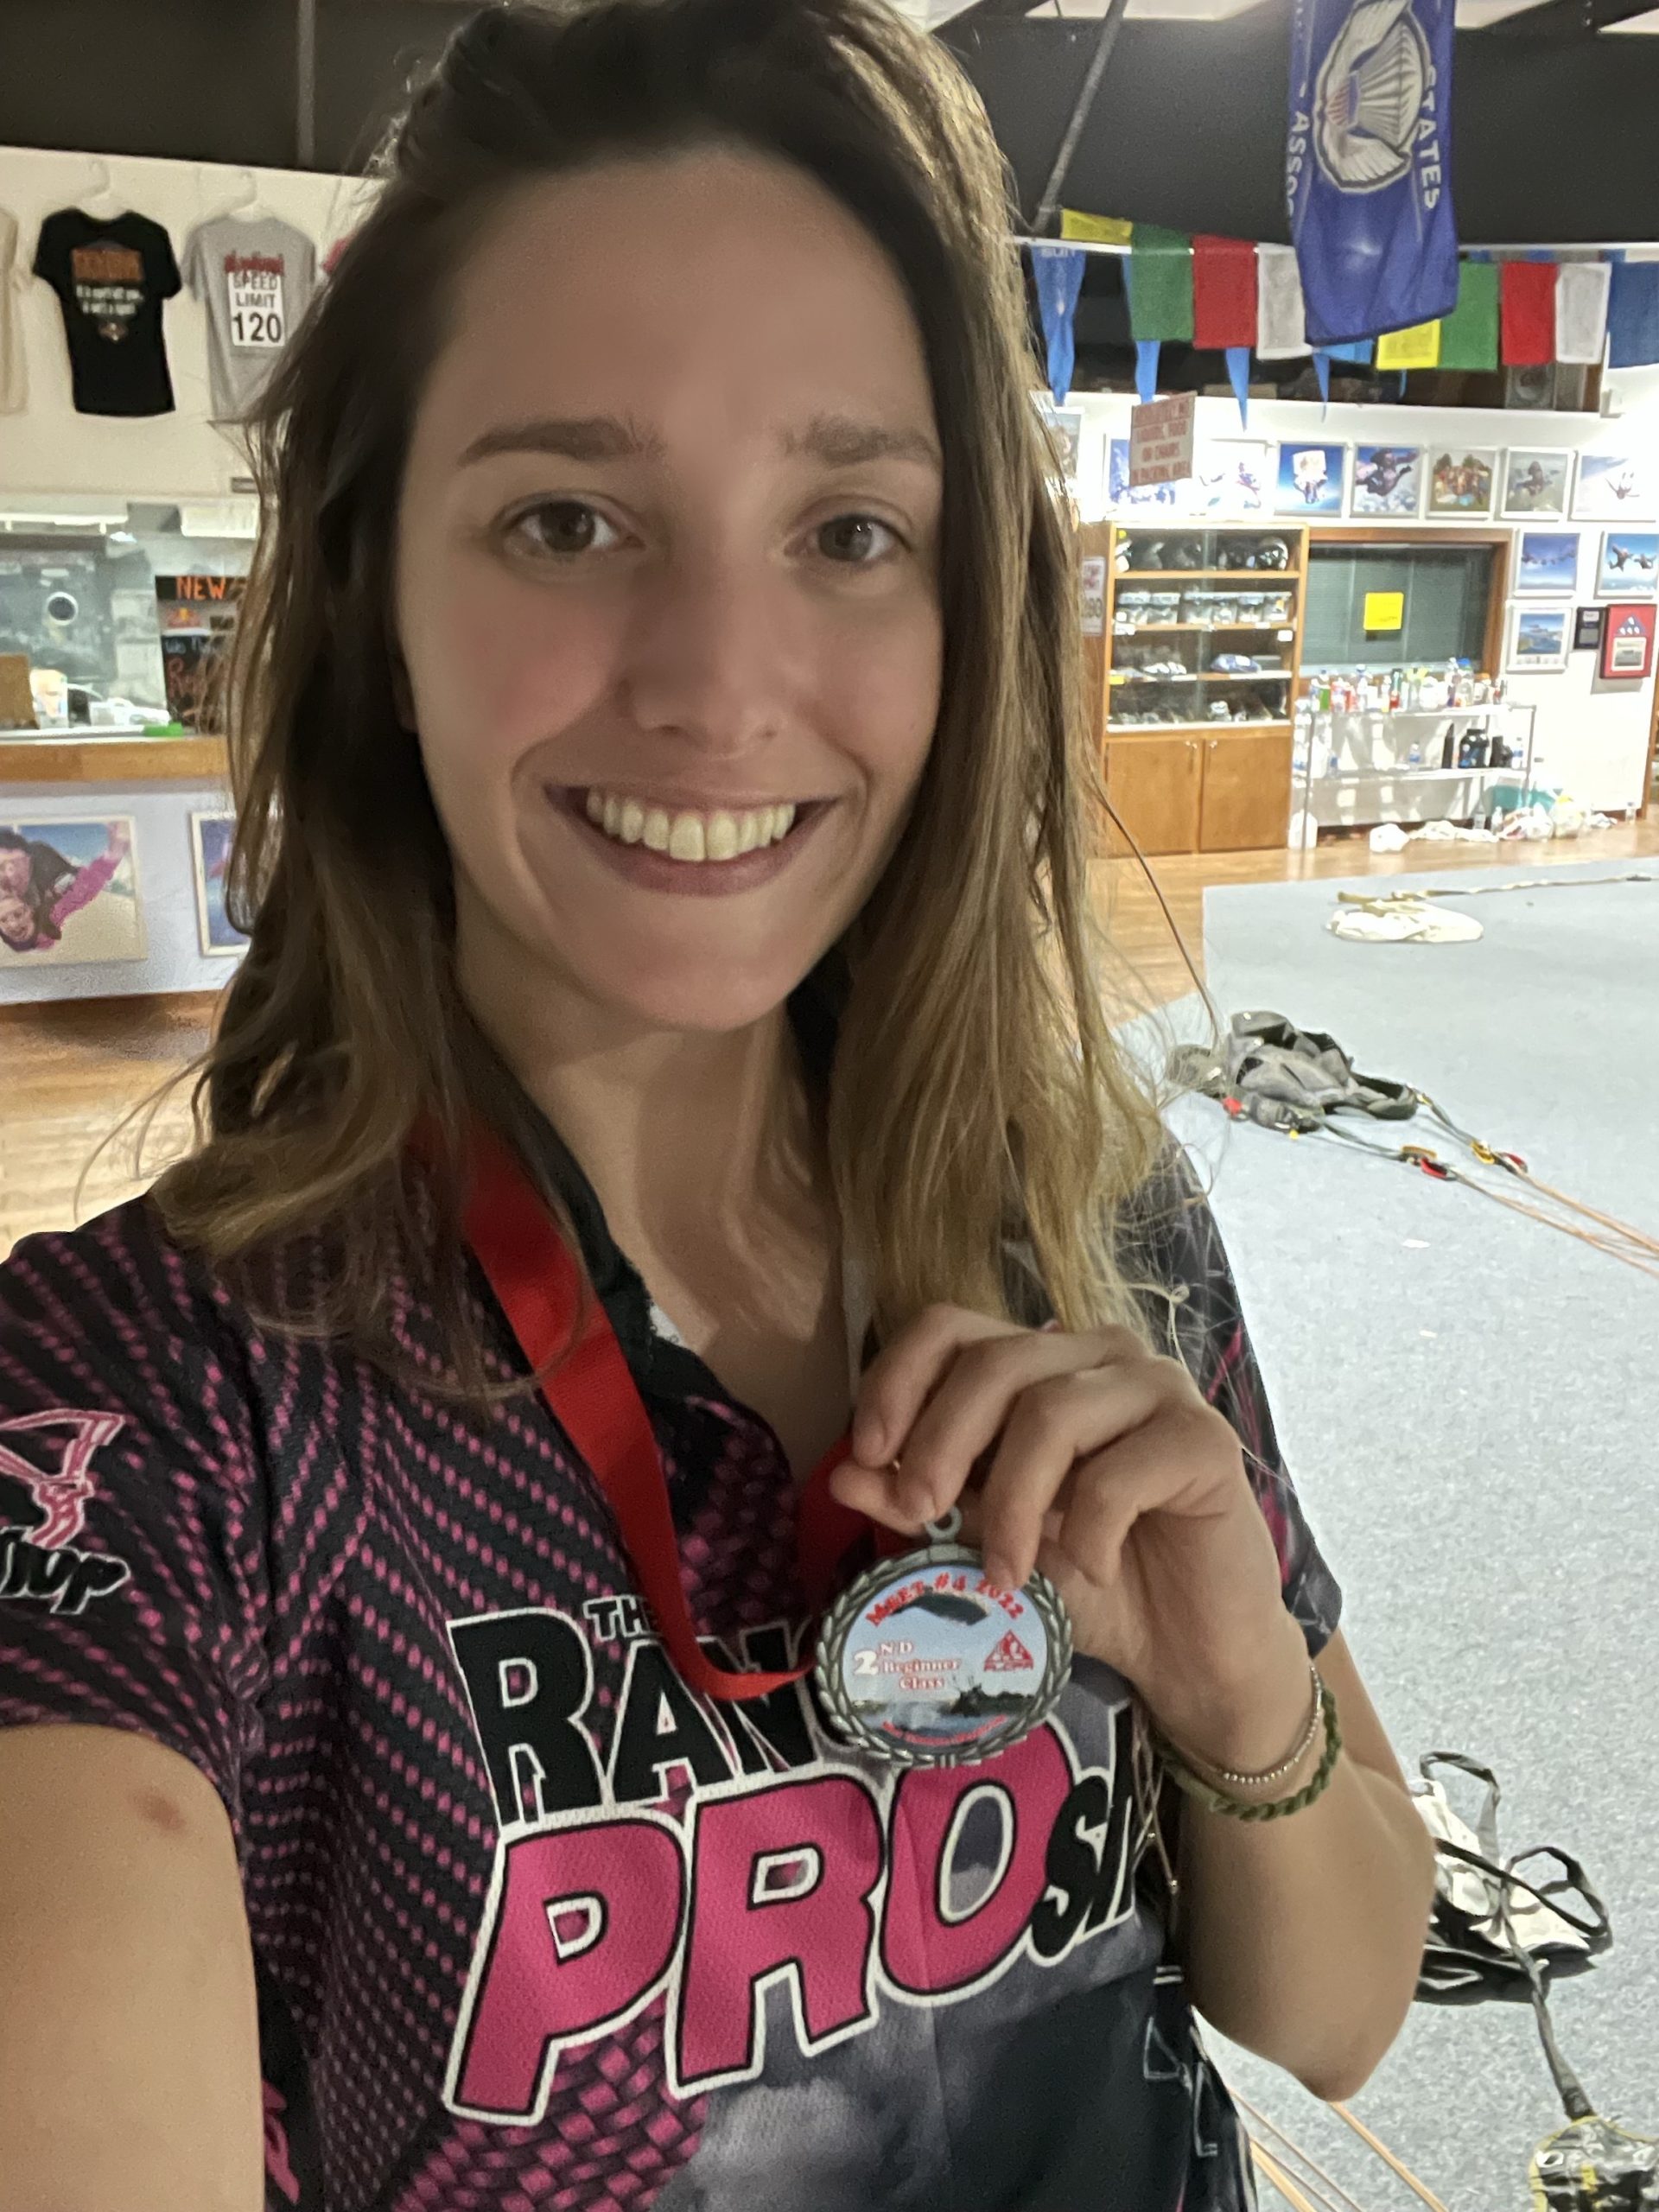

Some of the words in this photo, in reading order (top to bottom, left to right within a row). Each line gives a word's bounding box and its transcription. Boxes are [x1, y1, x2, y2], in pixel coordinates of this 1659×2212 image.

[232, 269, 277, 290] SPEED
[235, 292, 276, 308] LIMIT
[233, 312, 282, 343] 120
[175, 575, 226, 601] NEW
[866, 1580, 925, 1627] MEET
[975, 1578, 1025, 1620] 2022
[583, 1595, 658, 1642] TH
[882, 1657, 961, 1676] Beginner
[899, 1675, 944, 1691] Class
[447, 1607, 821, 1825] RAN
[442, 1715, 1082, 2127] PRO
